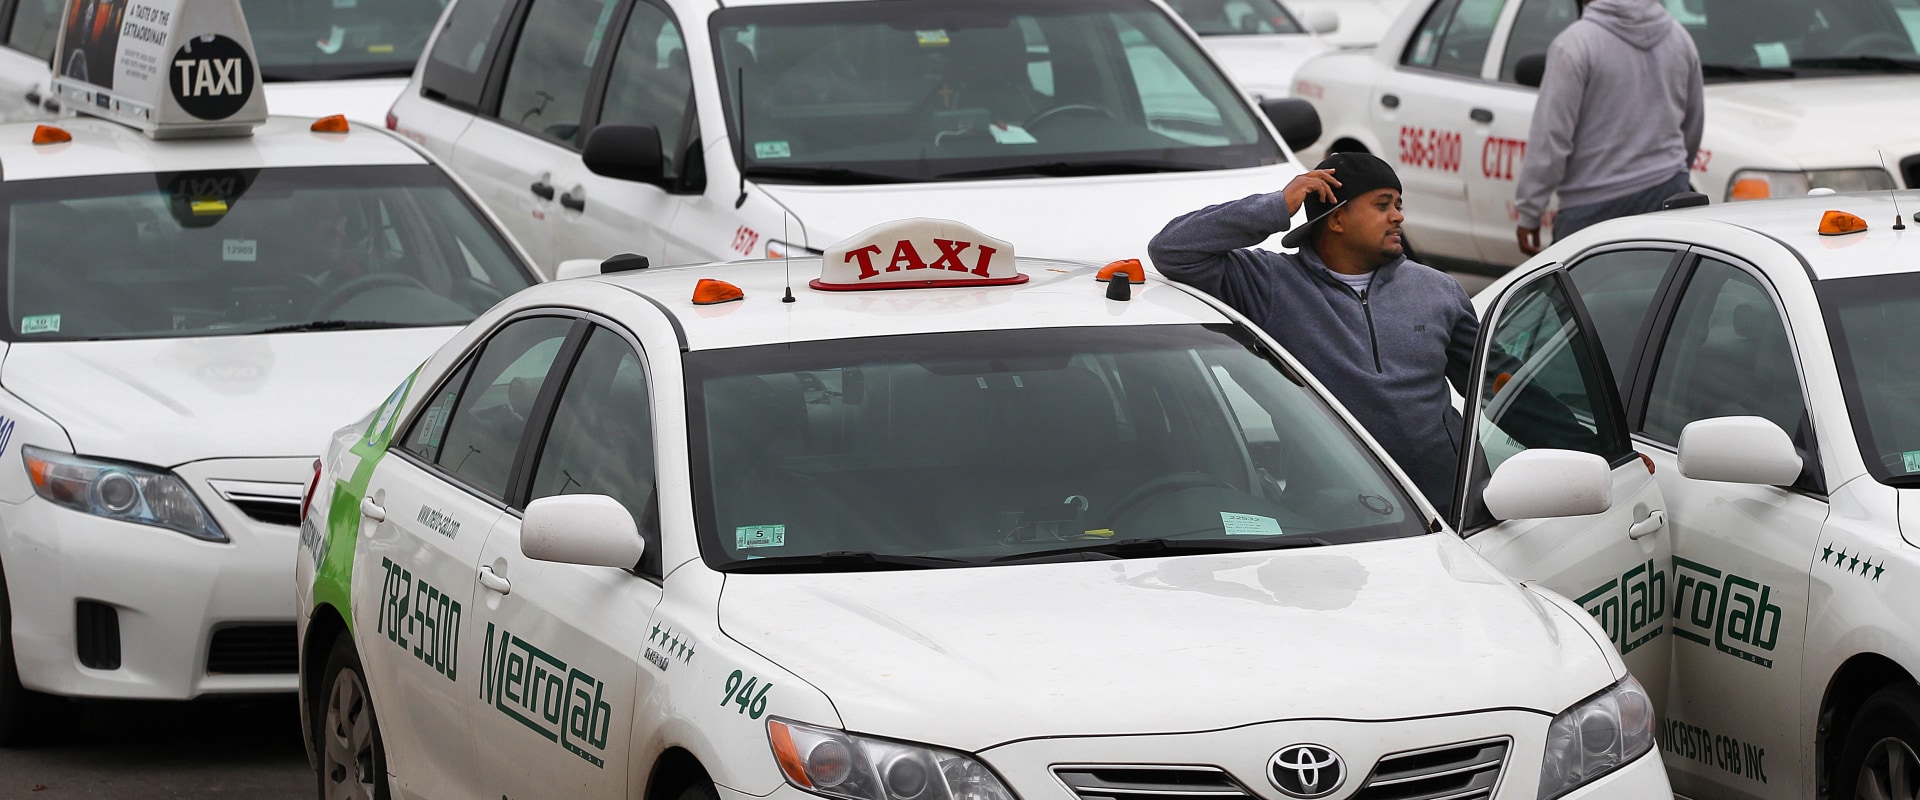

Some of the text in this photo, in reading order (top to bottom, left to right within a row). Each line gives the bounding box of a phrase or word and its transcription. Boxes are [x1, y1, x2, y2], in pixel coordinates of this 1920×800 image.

[122, 21, 167, 47] EXTRAORDINARY
[130, 4, 170, 26] A TASTE OF THE
[175, 57, 243, 97] TAXI
[1399, 126, 1463, 173] 536-5100
[731, 224, 760, 257] 1578
[844, 238, 998, 280] TAXI
[756, 530, 764, 538] 5
[377, 556, 462, 682] 782-5500
[1671, 554, 1782, 669] roCab
[720, 669, 773, 720] 946
[1716, 734, 1742, 775] CAB
[1743, 742, 1767, 784] INC
